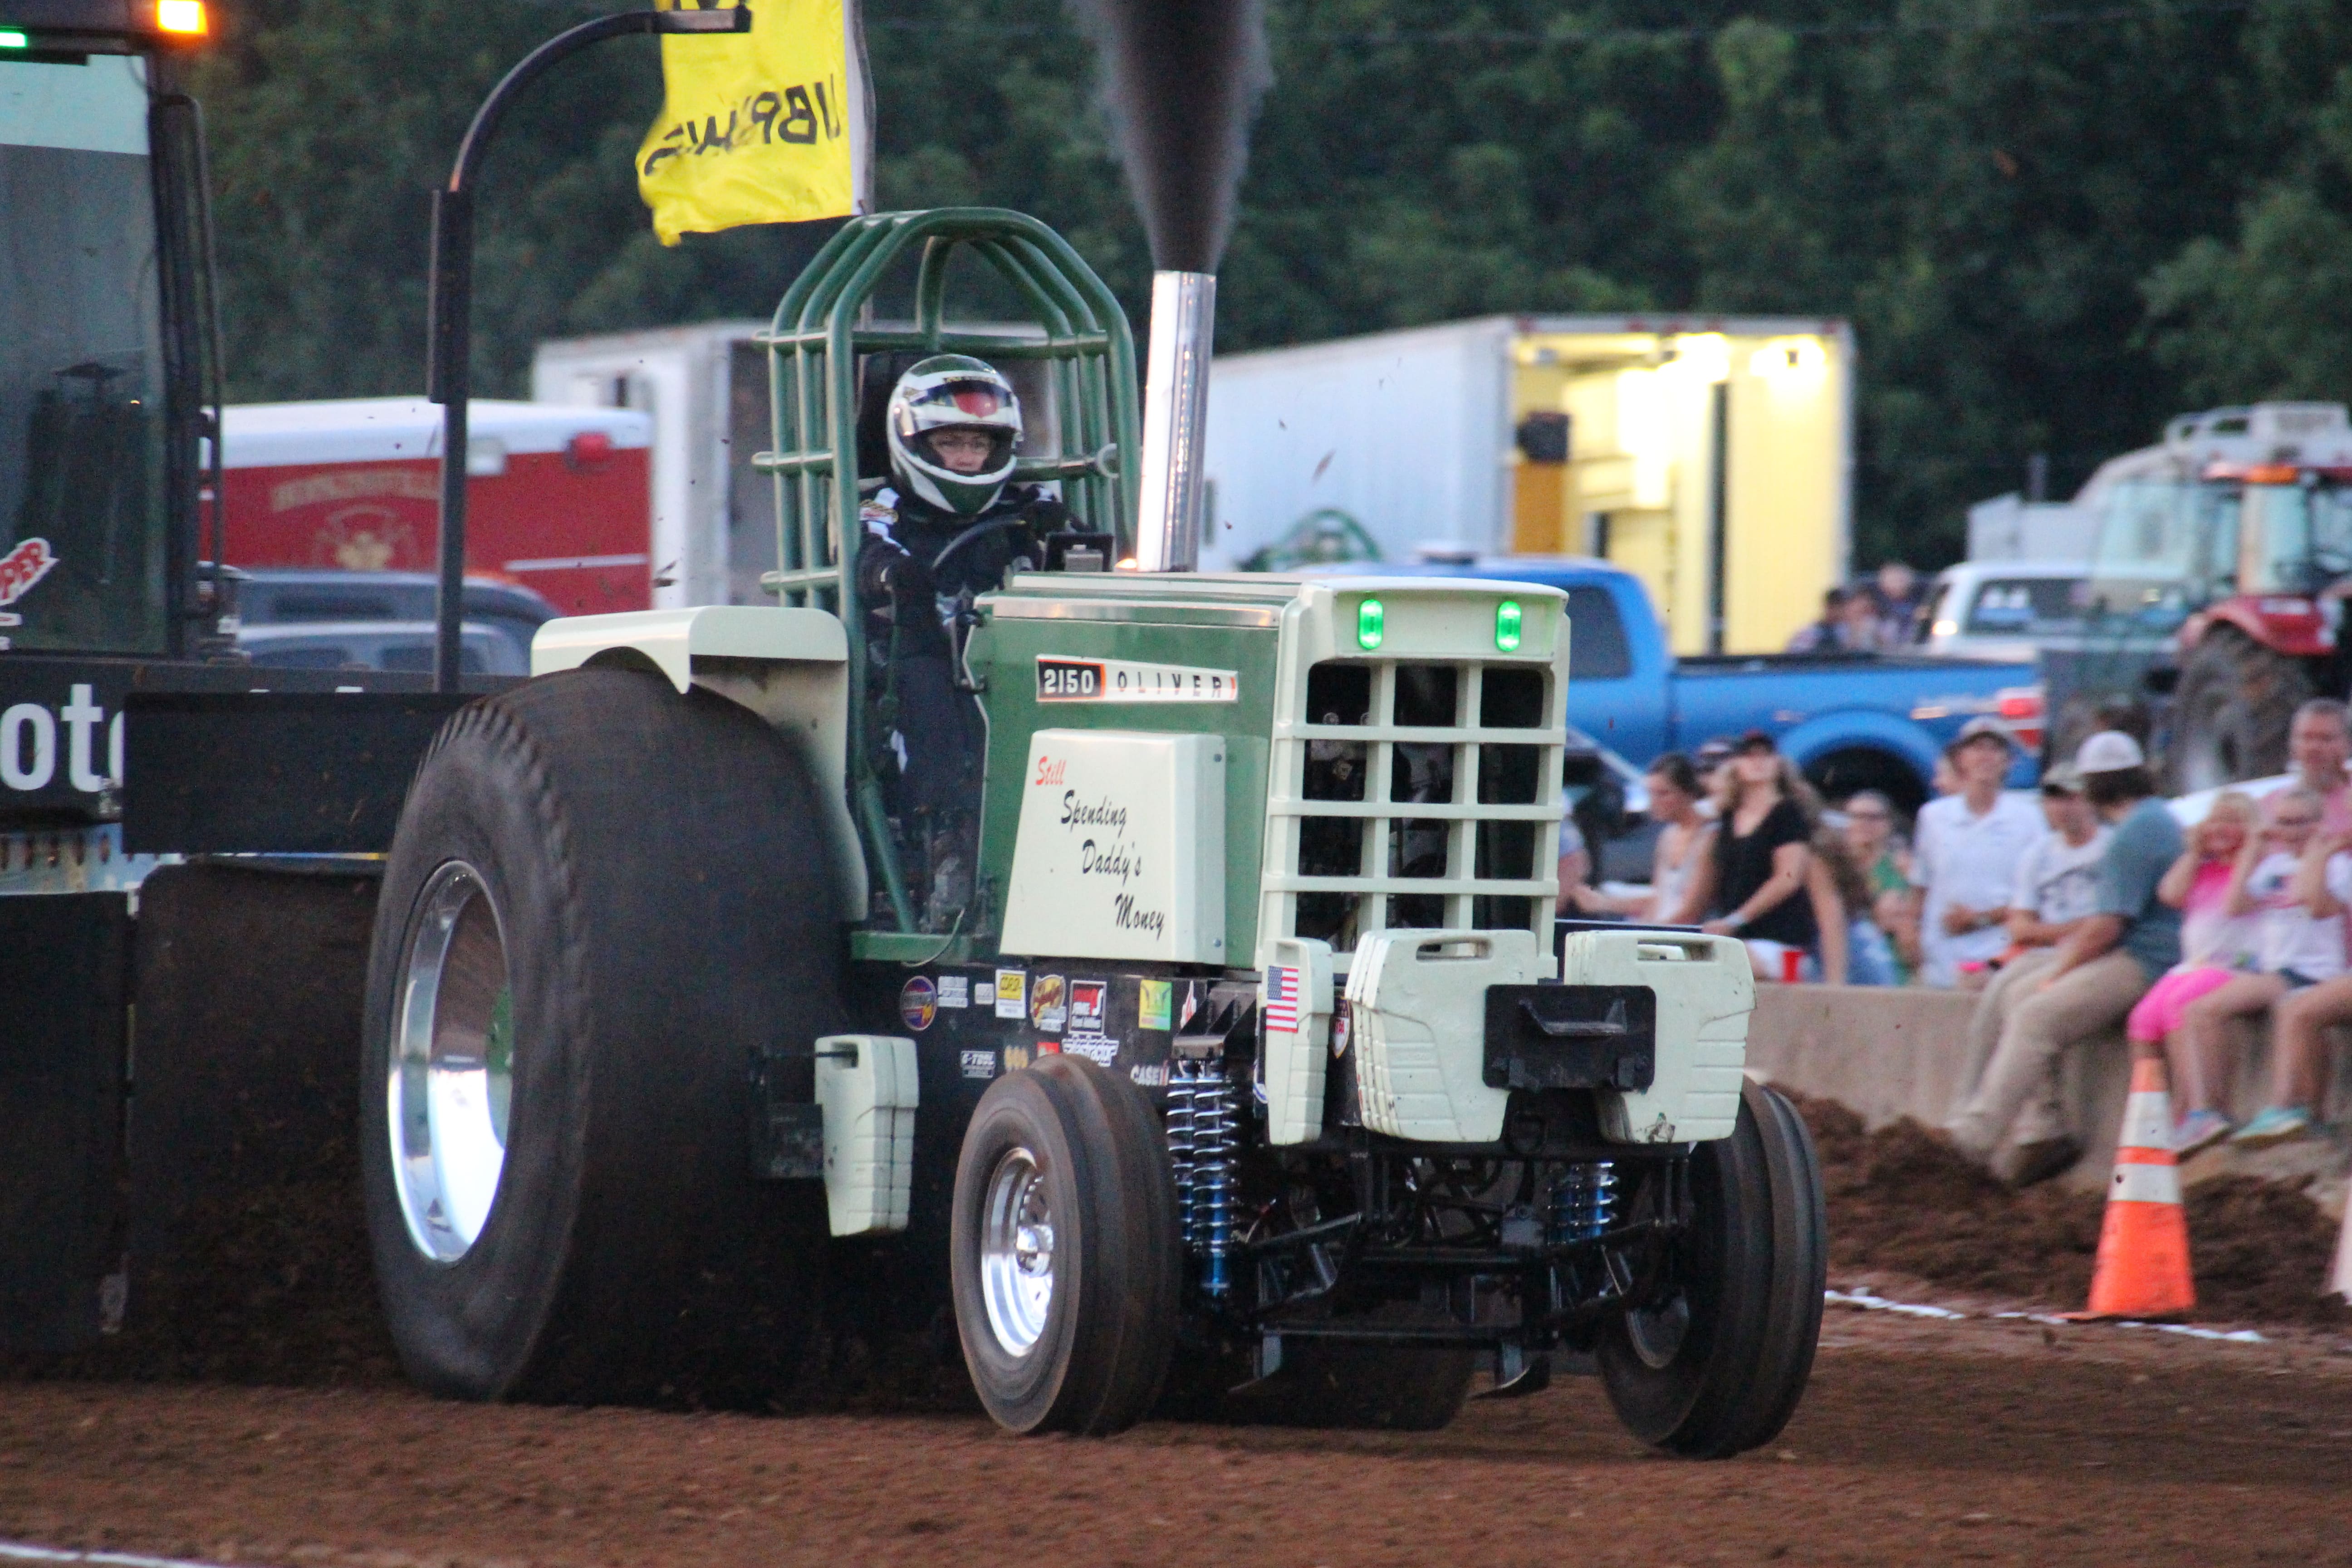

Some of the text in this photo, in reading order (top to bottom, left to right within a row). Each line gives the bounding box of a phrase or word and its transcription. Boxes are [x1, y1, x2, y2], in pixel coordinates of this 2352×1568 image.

[1044, 668, 1223, 699] 2150 OLIVER
[1035, 755, 1067, 786] Still
[1060, 789, 1127, 838] Spending
[1082, 838, 1142, 887] Daddy's
[1114, 892, 1165, 941] Money
[1130, 1063, 1160, 1086] CASE
